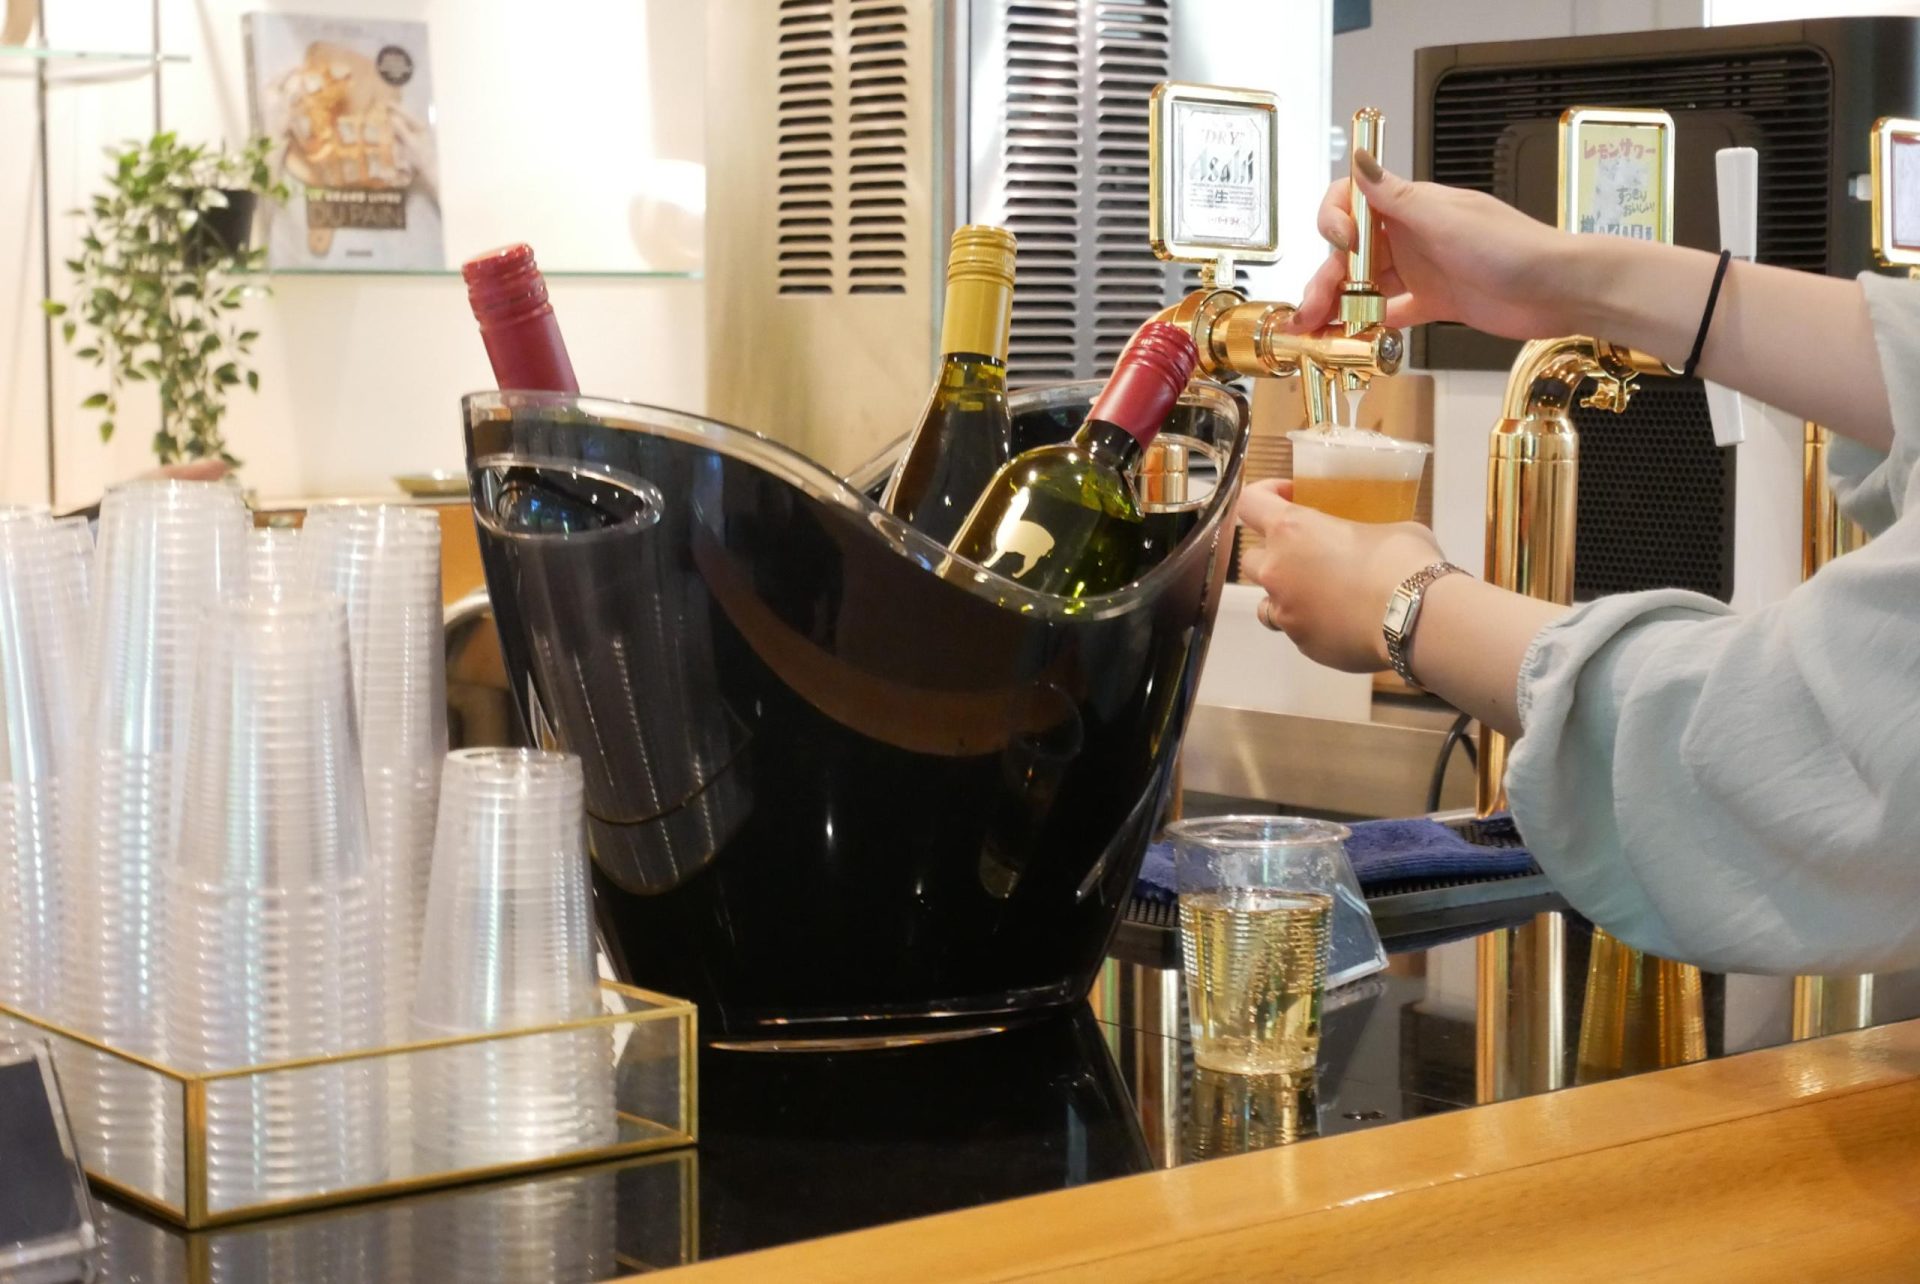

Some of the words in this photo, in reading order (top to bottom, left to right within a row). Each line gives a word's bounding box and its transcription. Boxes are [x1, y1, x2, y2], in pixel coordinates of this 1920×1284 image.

[1584, 138, 1656, 159] レモンサワー
[1190, 147, 1253, 184] Asahi
[1213, 188, 1228, 203] 生
[1616, 185, 1647, 205] すっきり
